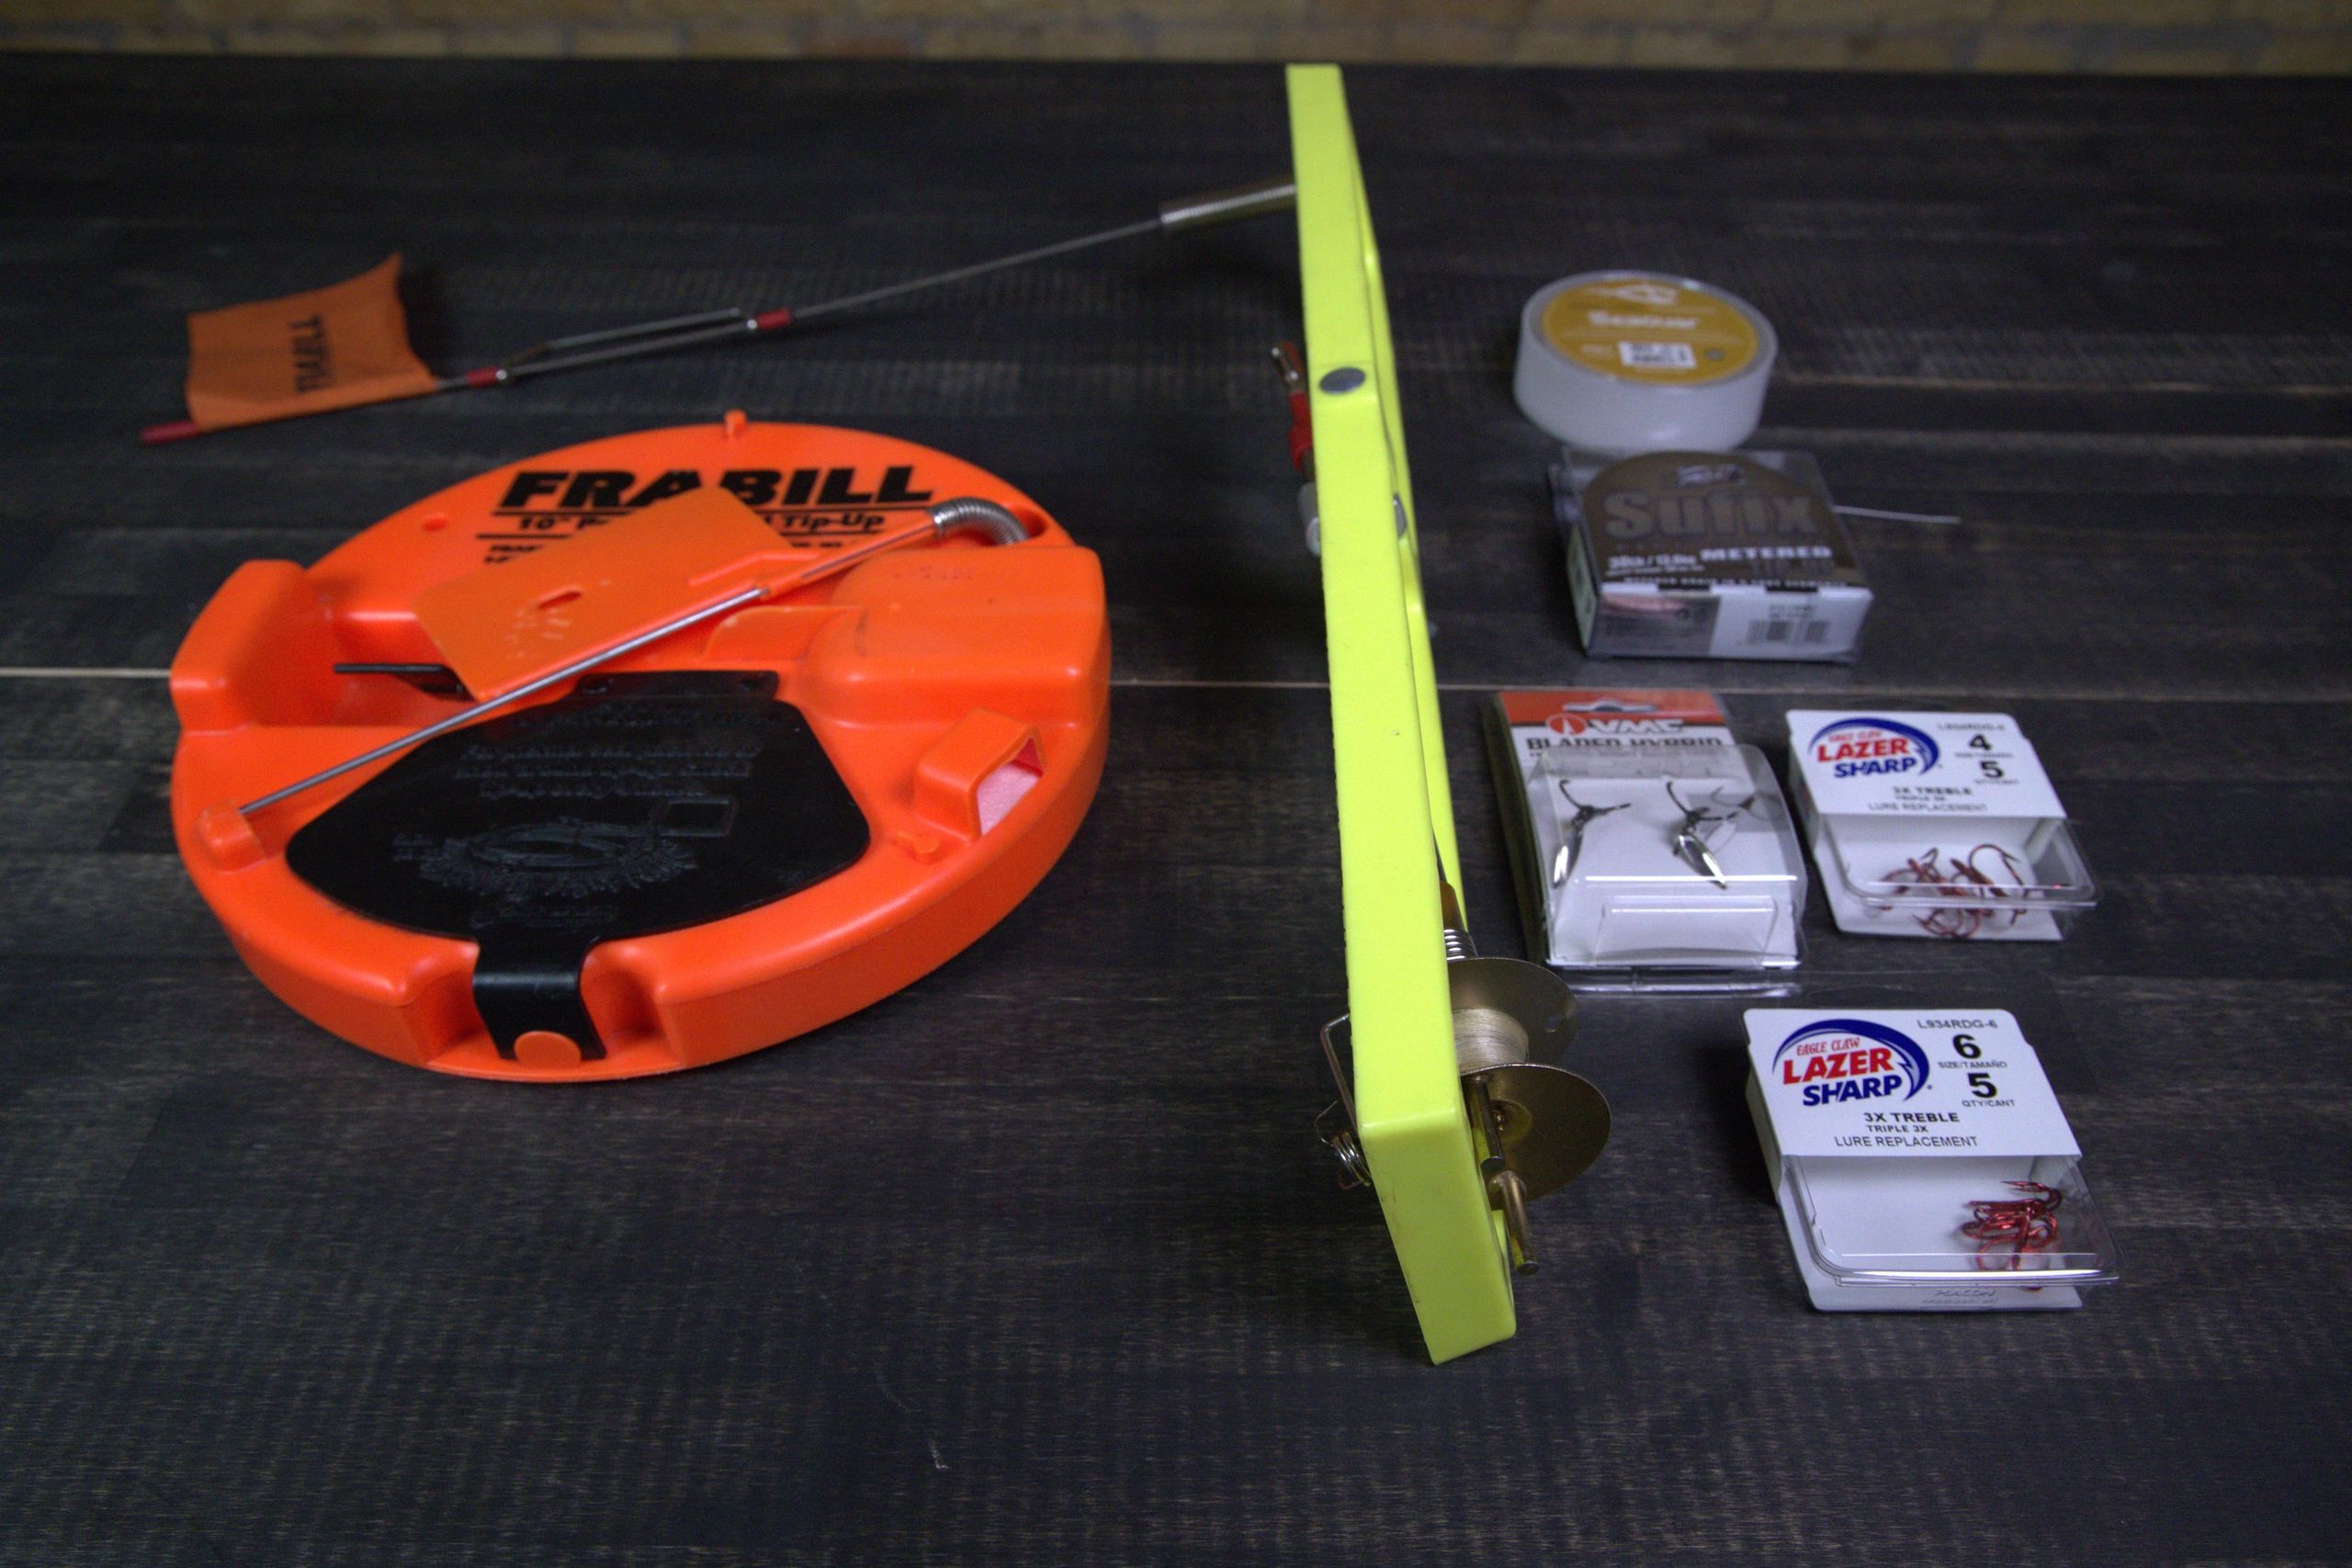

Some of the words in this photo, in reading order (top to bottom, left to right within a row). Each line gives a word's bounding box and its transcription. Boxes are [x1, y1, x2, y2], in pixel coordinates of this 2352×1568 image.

[500, 466, 933, 508] FRABILL
[784, 513, 885, 533] Tip-Up
[1701, 546, 1833, 561] METERED
[1589, 718, 1685, 734] VMC
[1817, 738, 1910, 762] LAZER
[1969, 733, 1993, 750] 4
[1834, 757, 1917, 779] SHARP
[1979, 760, 2005, 779] 5
[1917, 1020, 1998, 1029] L934RDG-6
[1796, 1042, 1827, 1056] EAGLE
[1830, 1037, 1860, 1052] CLAW
[1952, 1033, 1982, 1060] 6
[1783, 1047, 1895, 1085] LAZER
[1803, 1075, 1903, 1107] SHARP
[1967, 1071, 1998, 1099] 5
[1863, 1112, 1887, 1122] 3X
[1890, 1112, 1961, 1122] TREBLE
[1834, 1136, 1873, 1146] LURE
[1875, 1136, 1979, 1147] REPLACEMENT
